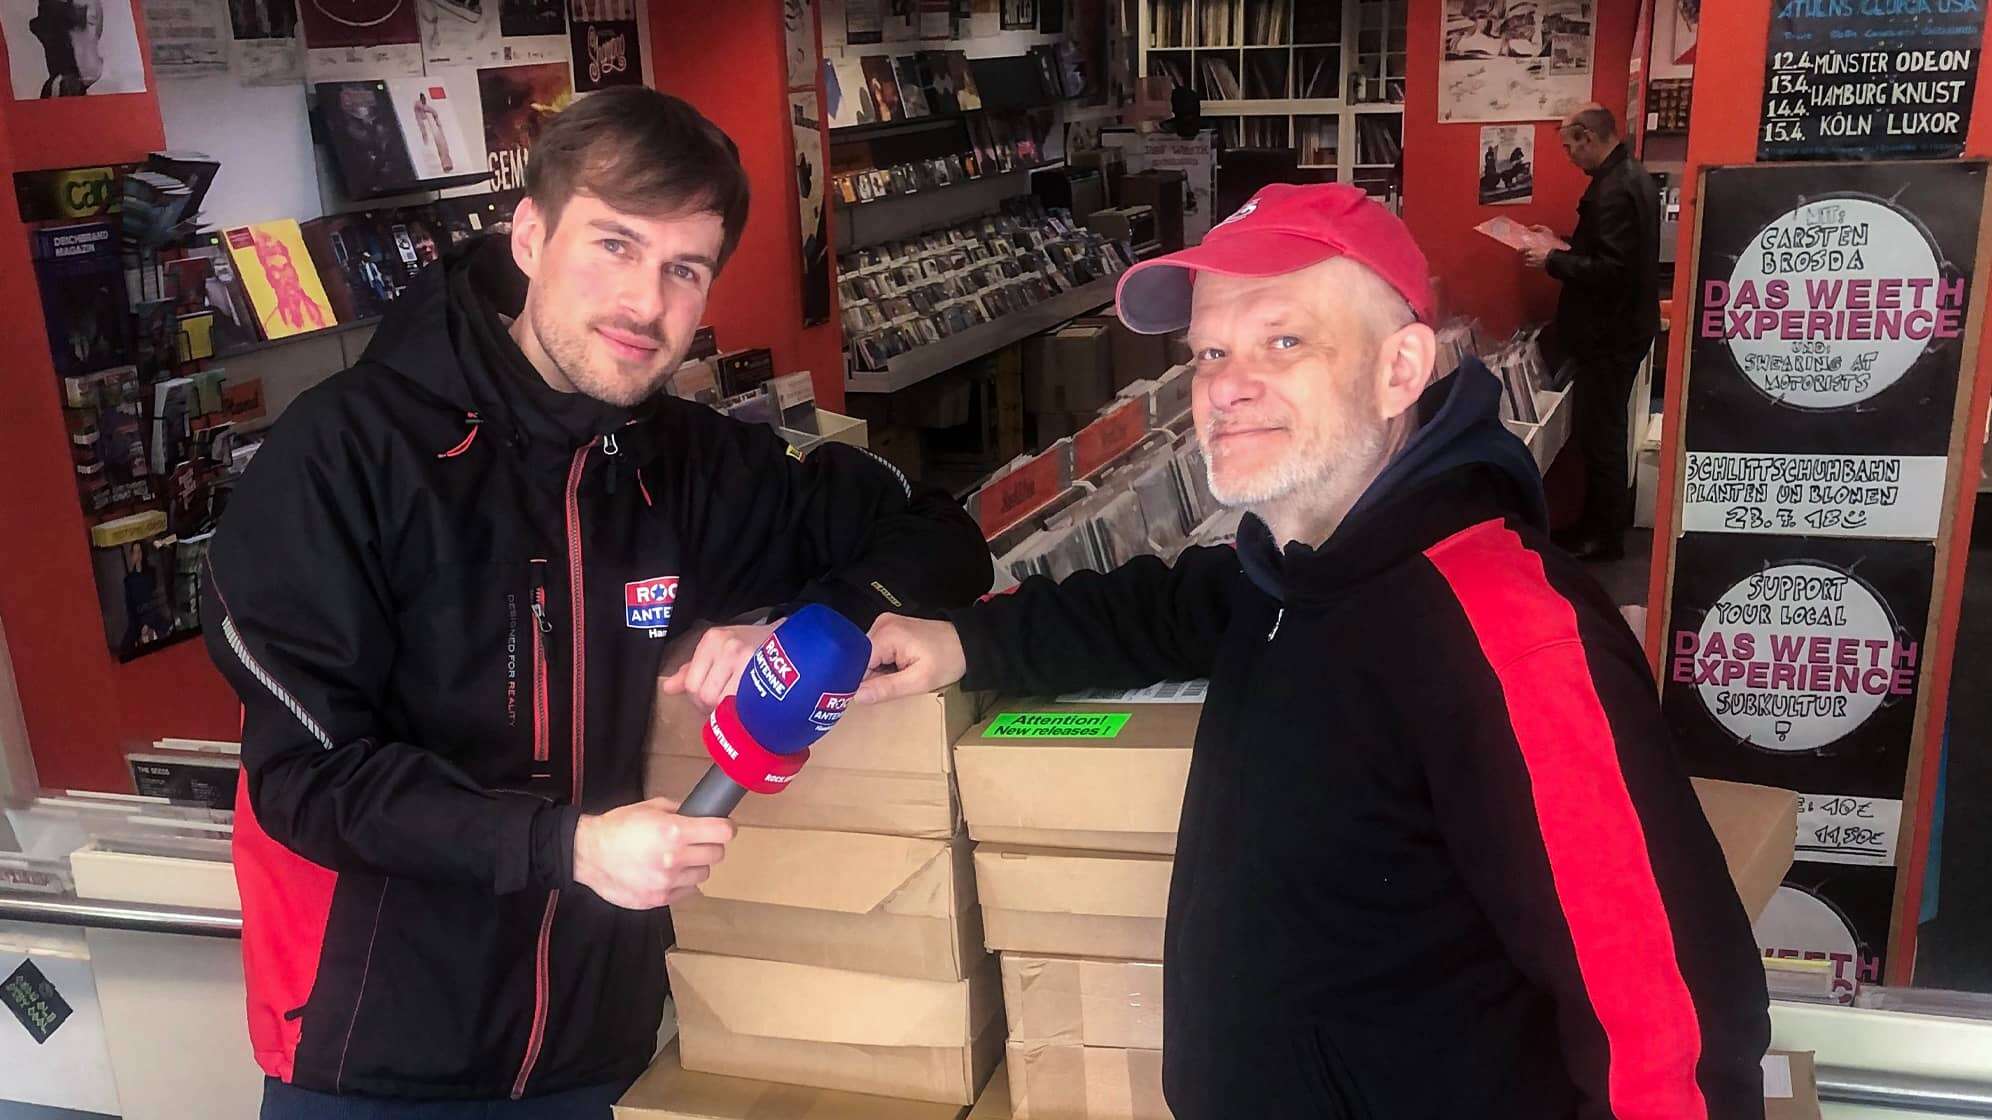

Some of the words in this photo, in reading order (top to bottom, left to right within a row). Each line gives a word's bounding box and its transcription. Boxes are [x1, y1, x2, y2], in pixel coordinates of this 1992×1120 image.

[1938, 0, 1977, 14] USA
[1814, 50, 1888, 75] MÜNSTER
[1895, 50, 1971, 72] ODEON
[1810, 82, 1887, 107] HAMBURG
[1891, 81, 1966, 104] KNUST
[1766, 99, 1810, 118] 14.4.
[1764, 122, 1806, 142] 15.4.
[1819, 111, 1872, 136] KÖLN
[1886, 112, 1961, 136] LUXOR
[1761, 223, 1869, 250] CARSTEN
[1762, 249, 1864, 275] BROSDA
[1703, 279, 1790, 311] DAS
[1805, 277, 1966, 311] WEETH
[1701, 310, 1962, 341] EXPERIENCE
[1744, 353, 1843, 373] SWEARING
[1851, 351, 1879, 371] AT
[1765, 373, 1872, 394] MOTORISTS
[1687, 455, 1901, 483] SCHLITTSCHUHBAHN
[1686, 483, 1768, 503] PLANTEN
[1776, 484, 1803, 504] UN
[1725, 506, 1773, 529] 23.
[1747, 574, 1848, 602] SUPPORT
[1716, 603, 1772, 625] YOUR
[1780, 605, 1848, 626] LOCAL
[766, 639, 793, 680] ROCK
[1675, 630, 1755, 660] DAS
[1769, 634, 1919, 670] WEETH
[507, 654, 516, 678] FOR
[1672, 656, 1916, 696] EXPERIENCE
[507, 681, 517, 727] REALITY
[1716, 691, 1847, 718] SUBKULTUR
[994, 725, 1032, 736] New
[1031, 725, 1101, 736] releases
[1010, 715, 1109, 726] Attention!
